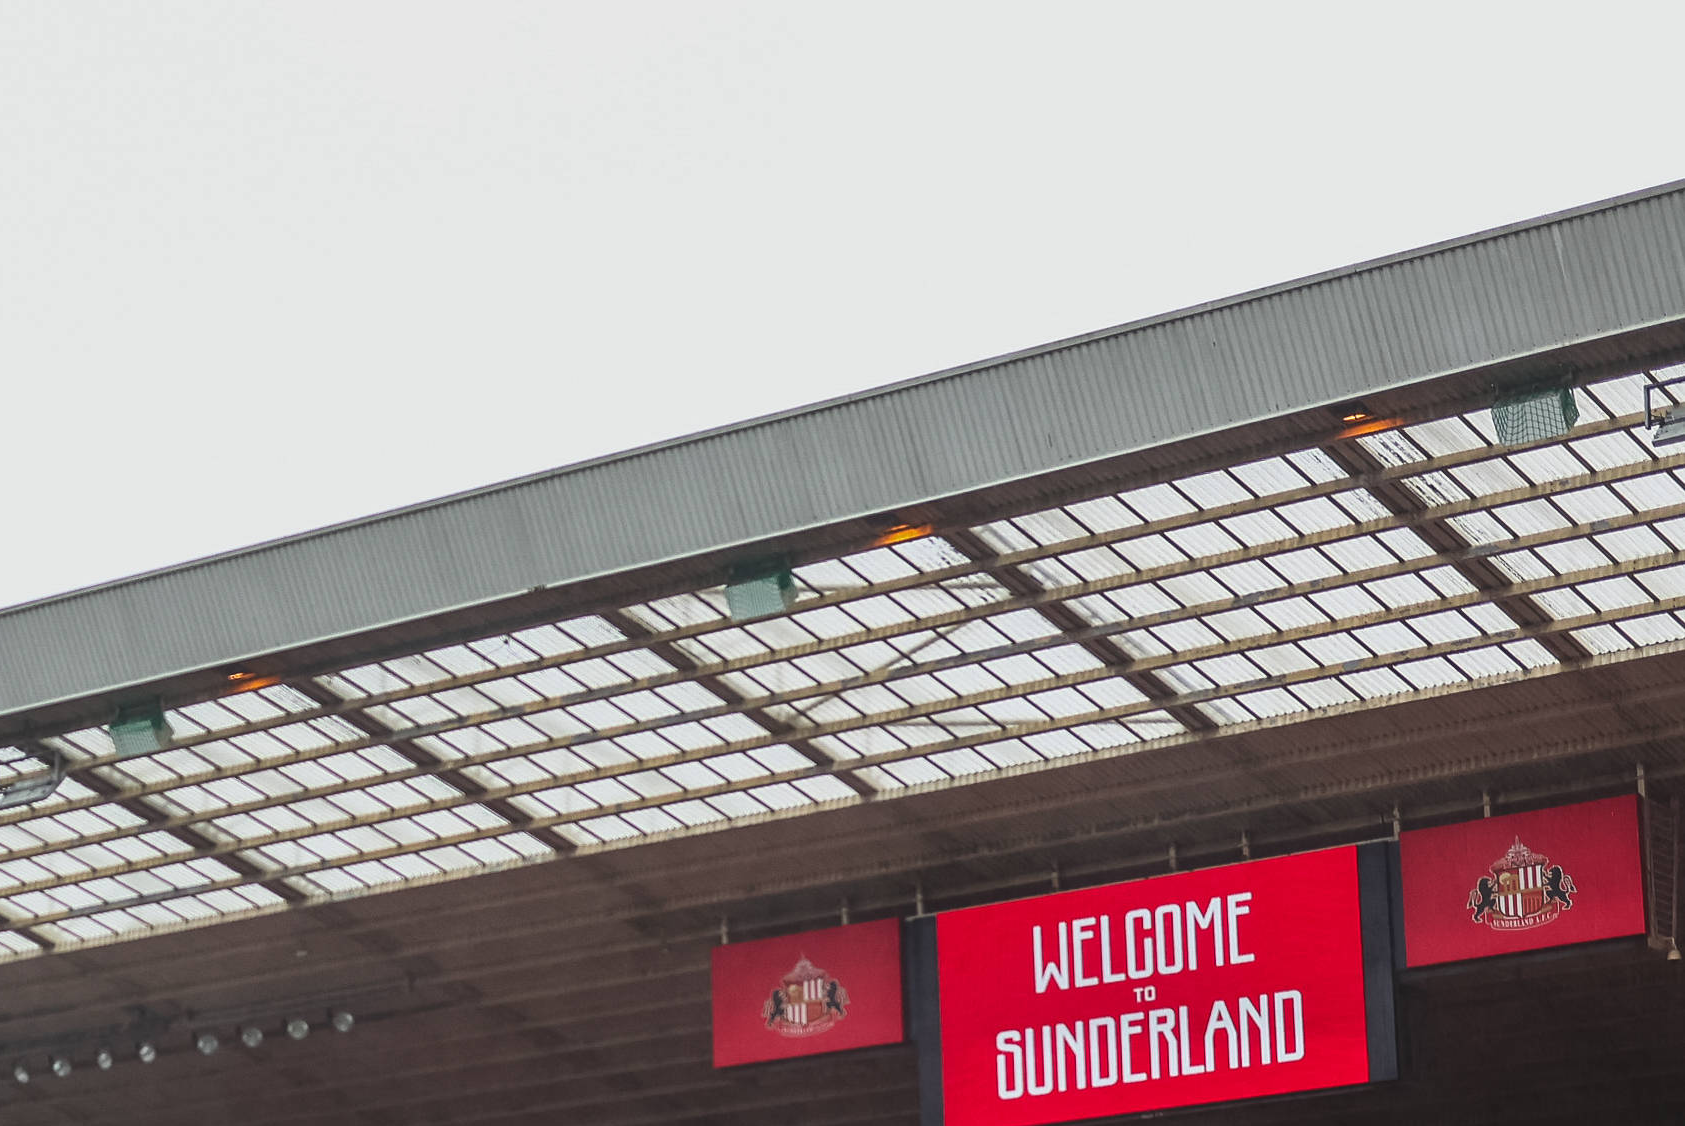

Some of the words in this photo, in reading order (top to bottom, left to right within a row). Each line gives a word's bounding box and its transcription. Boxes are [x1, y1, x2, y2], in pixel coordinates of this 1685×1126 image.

[1032, 892, 1256, 994] WELCOME
[1133, 985, 1157, 1003] TO
[995, 989, 1306, 1101] SUNDERLAND
